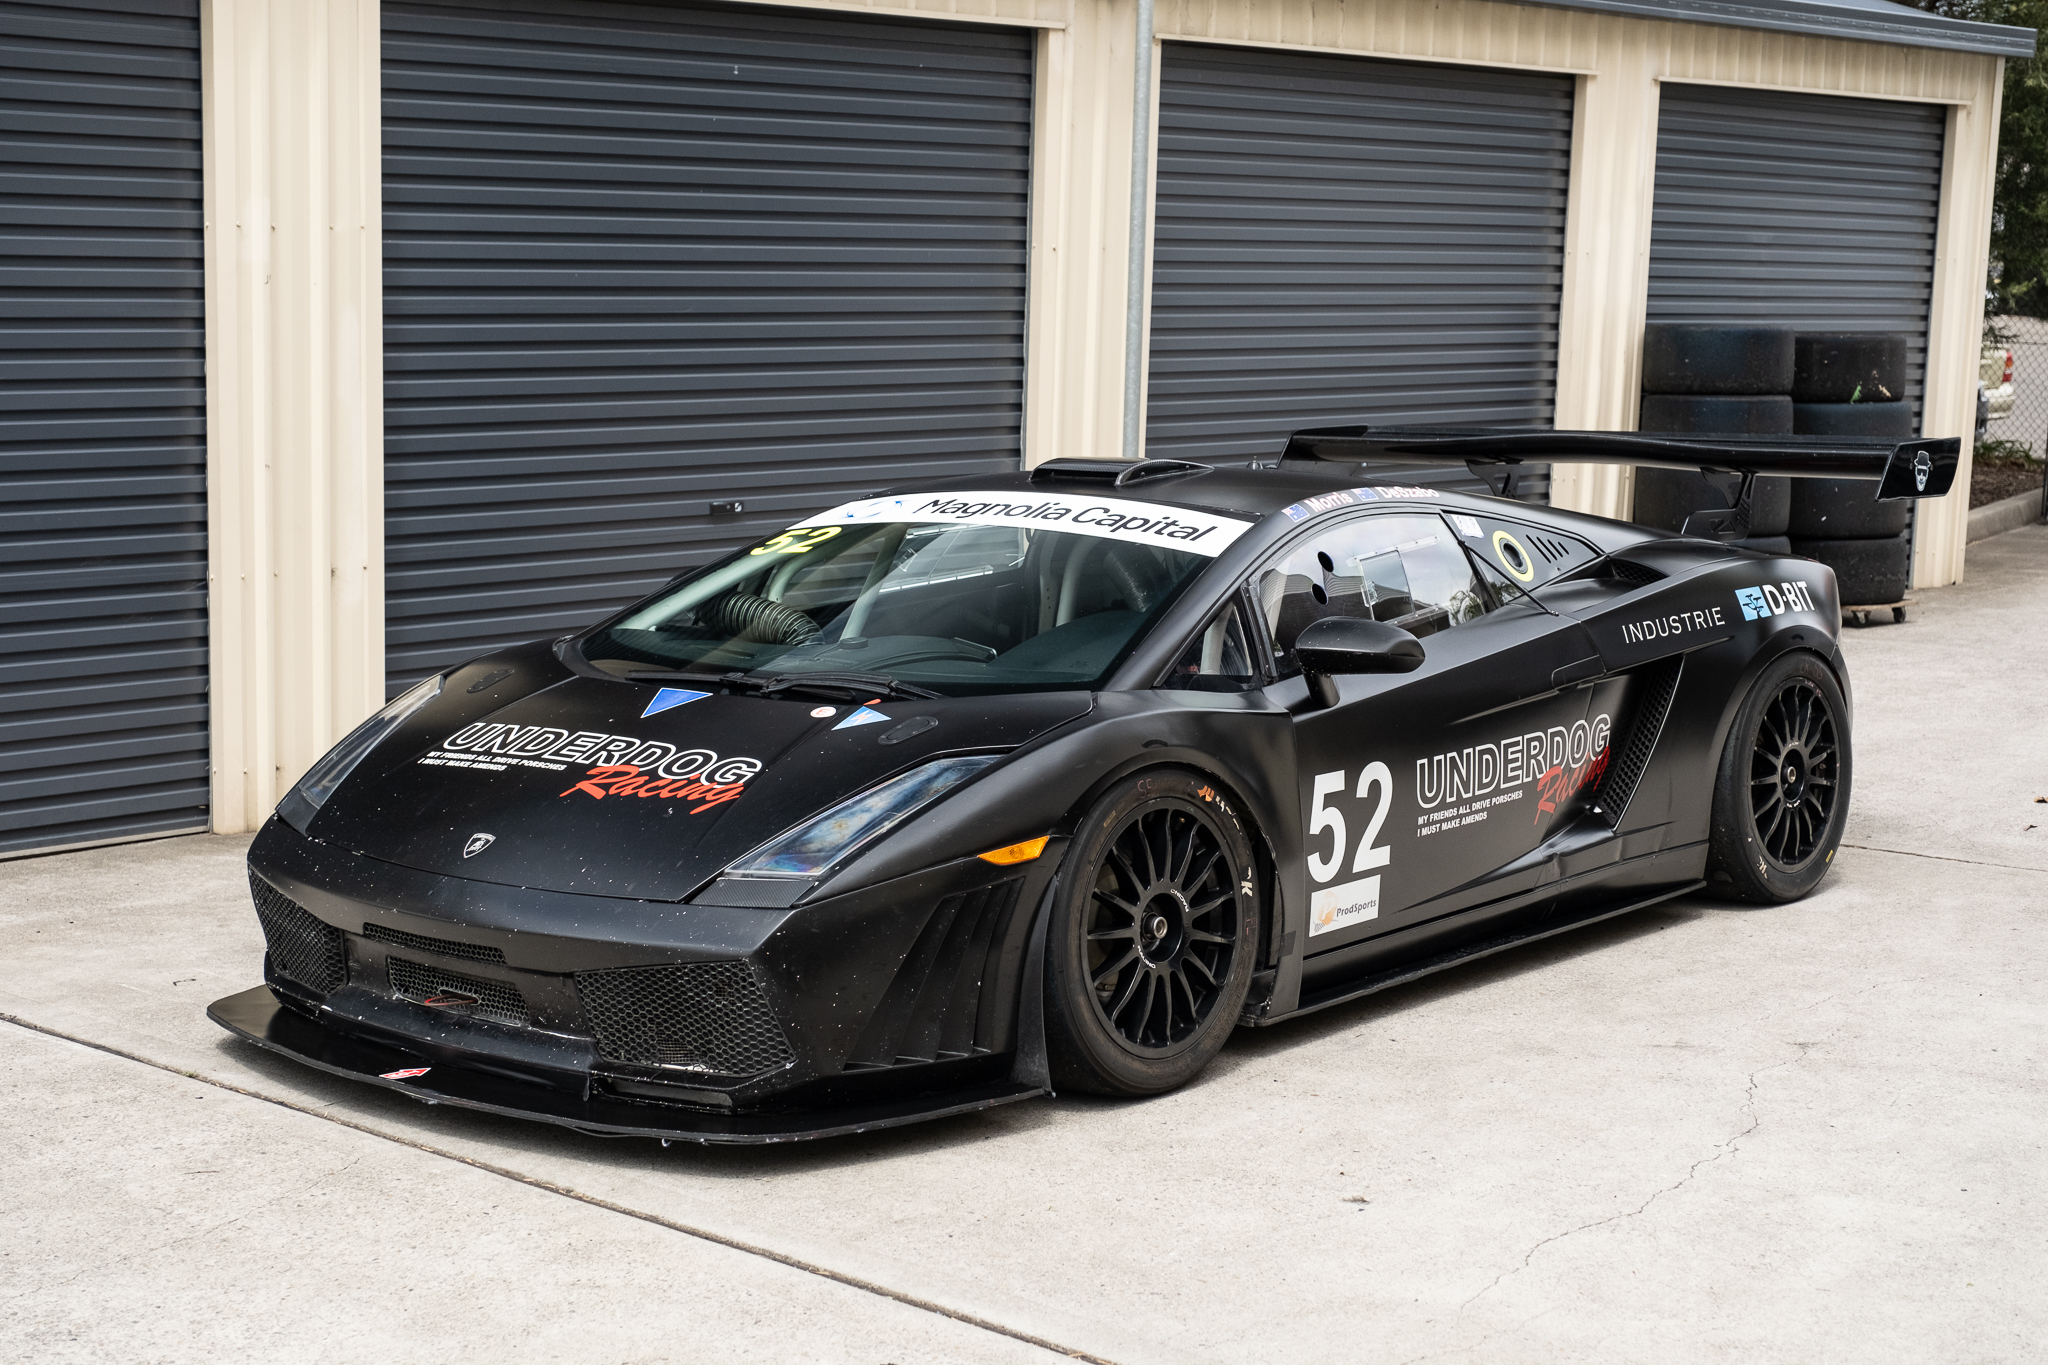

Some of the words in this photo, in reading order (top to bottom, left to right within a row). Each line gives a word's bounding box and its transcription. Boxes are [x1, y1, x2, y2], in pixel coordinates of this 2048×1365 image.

[913, 498, 1073, 521] Magnolia
[1071, 506, 1218, 541] Capital
[1304, 492, 1354, 513] Morris
[750, 526, 842, 555] 52
[1621, 606, 1725, 644] INDUSTRIE
[422, 758, 447, 766] MUST
[446, 760, 471, 768] MAKE
[469, 762, 508, 771] AMENDS
[441, 752, 477, 761] FRIENDS
[492, 756, 521, 765] DRIVE
[518, 759, 567, 771] PORSCHES
[443, 722, 762, 788] UNDERDOG
[1416, 713, 1611, 809] UNDERDOG
[559, 764, 744, 814] Racing
[1307, 761, 1393, 883] 52
[1417, 815, 1428, 825] MY
[1429, 808, 1457, 822] FRIENDS
[1459, 804, 1471, 814] ALL
[1472, 798, 1491, 812] DRIVE
[1491, 790, 1523, 806] PORSCHES
[1421, 823, 1440, 837] MUST
[1441, 818, 1460, 831] MAKE
[1461, 811, 1487, 826] AMENDS
[1336, 899, 1377, 918] ProdSports
